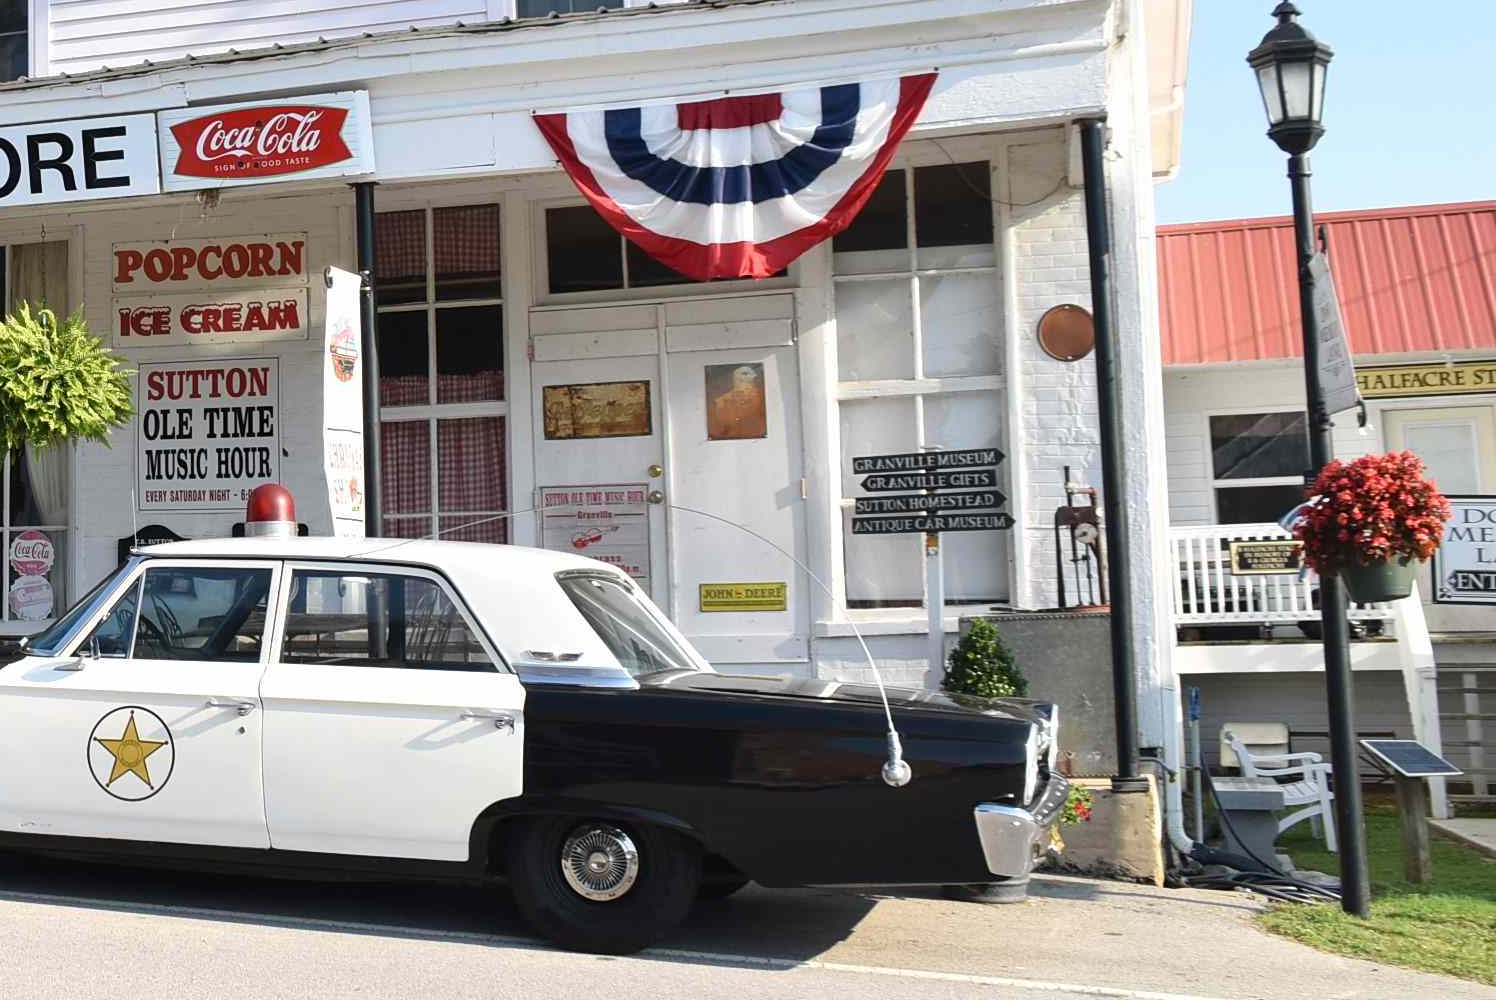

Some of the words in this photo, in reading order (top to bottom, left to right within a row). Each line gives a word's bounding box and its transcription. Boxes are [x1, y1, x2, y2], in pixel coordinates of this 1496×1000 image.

[215, 164, 235, 172] SIGN
[254, 160, 281, 169] OOD
[285, 157, 310, 165] TASTE
[114, 241, 304, 283] POPCORN
[119, 306, 171, 336] ICE
[180, 300, 300, 334] CREAM
[147, 367, 270, 401] SUTTON
[143, 408, 193, 440] OLE
[203, 406, 274, 439] TIME
[145, 448, 208, 480] MUSIC
[215, 447, 272, 478] HOUR
[854, 455, 935, 471] GRANVILLE
[937, 451, 996, 466] MUSEUM
[867, 475, 946, 489] GRANVILLE
[949, 472, 990, 486] GIFTS
[145, 490, 167, 503] EVERY
[170, 489, 207, 502] SATURDAY
[210, 489, 231, 501] NIGHT
[545, 493, 568, 506] SUTTON
[585, 492, 602, 505] TIME
[856, 499, 907, 512] SUTTON
[909, 494, 995, 509] HOMESTEAD
[854, 519, 913, 532] ANTIQUE
[914, 517, 945, 530] CAR
[948, 516, 1006, 529] MUSEUM
[704, 588, 733, 600] JOHN
[744, 587, 783, 599] DEERE
